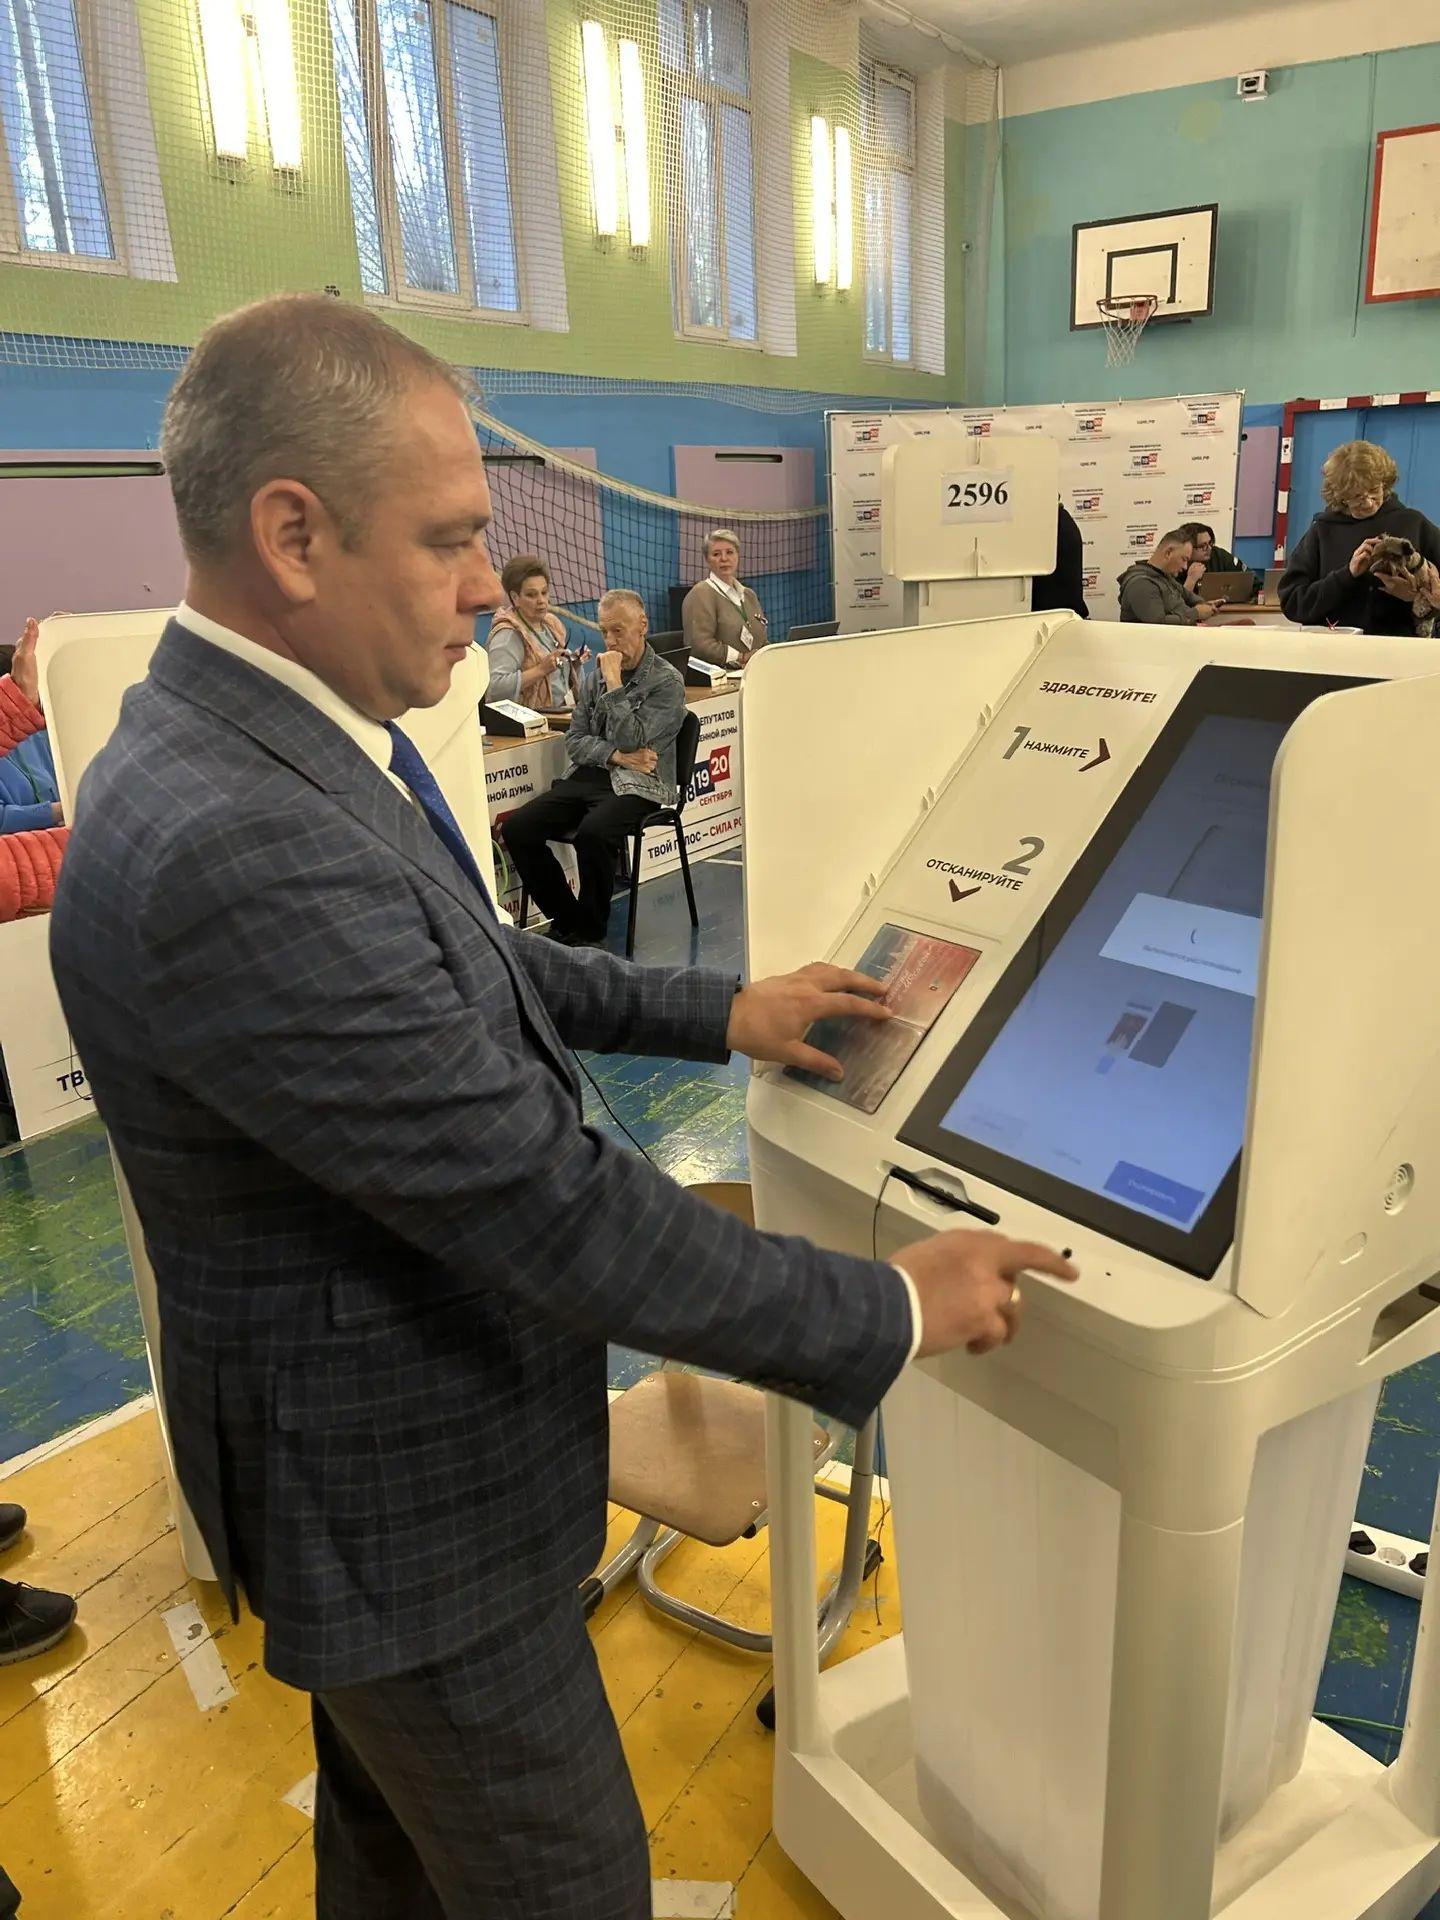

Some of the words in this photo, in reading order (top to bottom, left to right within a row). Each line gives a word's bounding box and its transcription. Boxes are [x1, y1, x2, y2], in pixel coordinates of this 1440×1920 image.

[947, 480, 1008, 507] 2596
[1039, 681, 1157, 703] ЗДРАВСТВУЙТЕ!
[720, 725, 738, 738] ДУМЫ
[1002, 725, 1031, 760] 1
[1023, 740, 1090, 759] НАЖМИТЕ
[695, 768, 710, 789] 19
[710, 755, 728, 776] 20
[509, 782, 534, 799] ДУМЫ
[699, 789, 733, 807] СЕНТЯБРЯ
[648, 839, 673, 859] ТВОЙ
[674, 831, 701, 851] ГЛОС
[709, 819, 733, 837] СИЛА
[1000, 836, 1045, 876] 2
[926, 858, 1024, 891] ОТСКАНИРУЙТЕ
